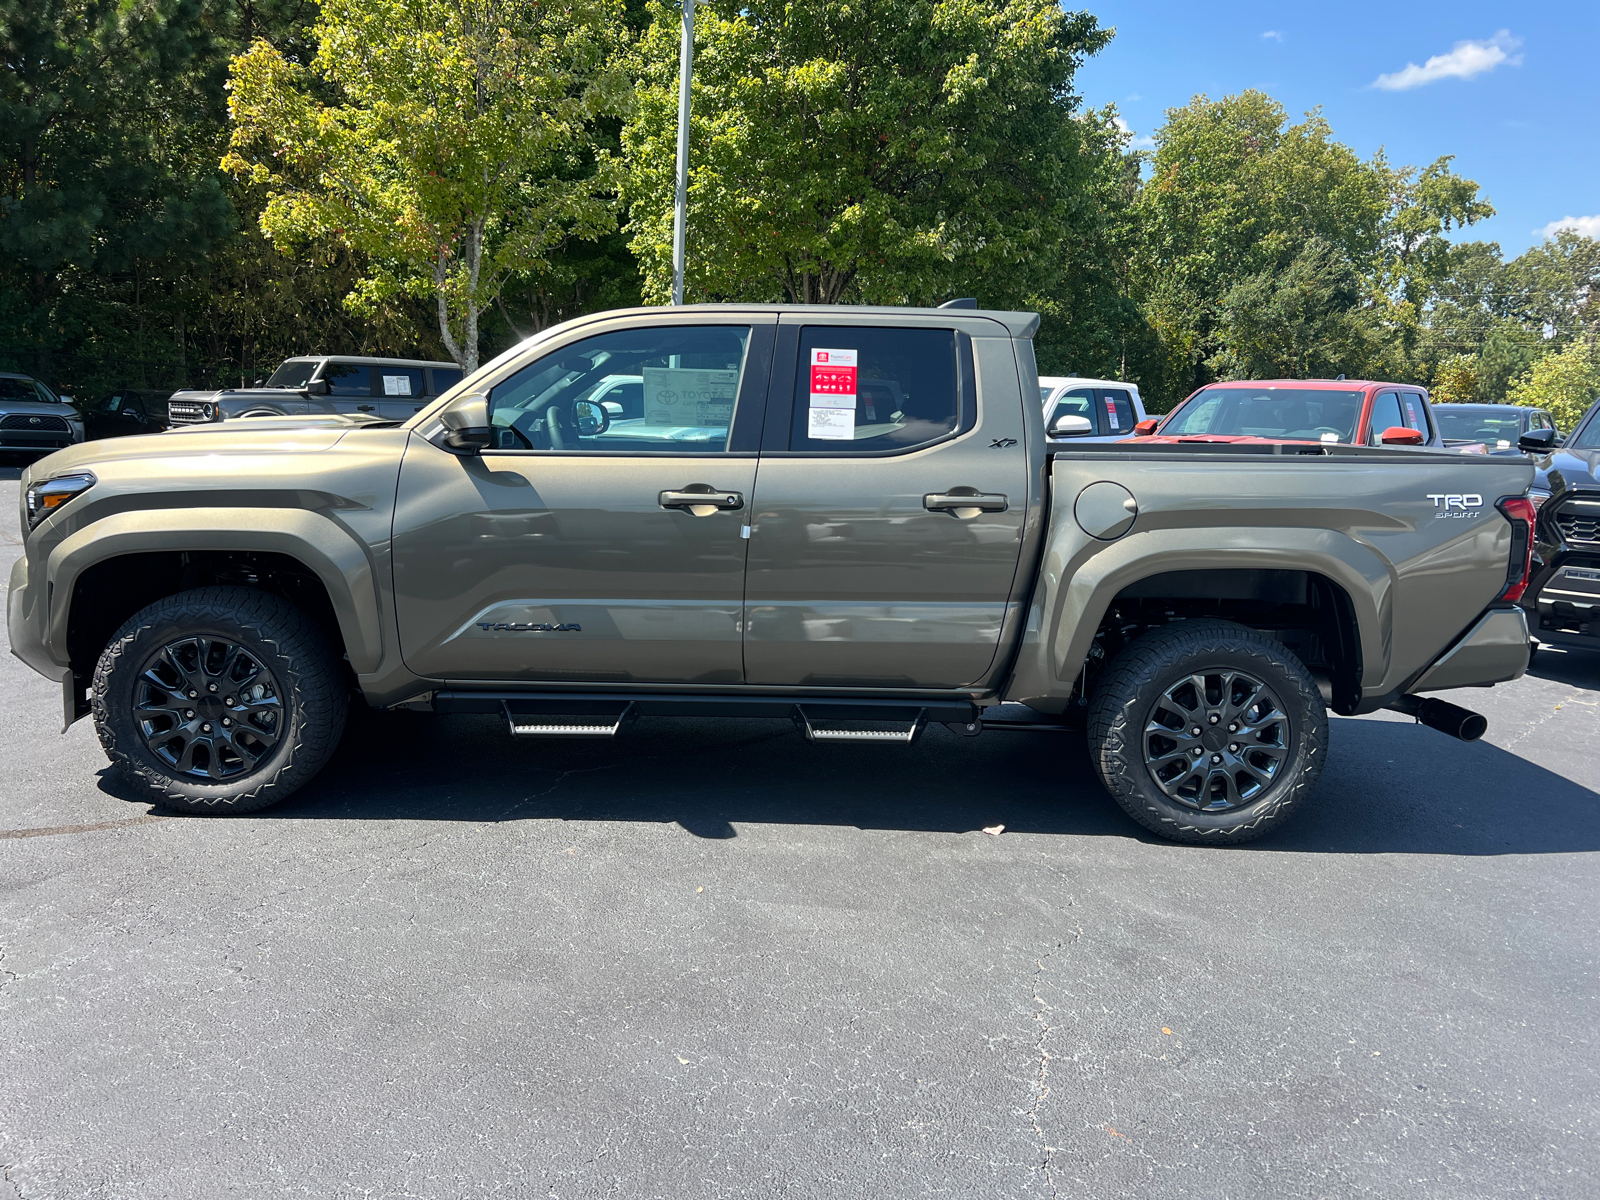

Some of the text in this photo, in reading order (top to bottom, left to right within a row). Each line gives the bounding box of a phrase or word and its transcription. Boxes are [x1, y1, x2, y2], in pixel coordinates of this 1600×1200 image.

[681, 390, 724, 400] TOYOTA
[1426, 493, 1484, 511] TRD
[1434, 511, 1480, 519] SPORT
[476, 622, 582, 632] TACOMA
